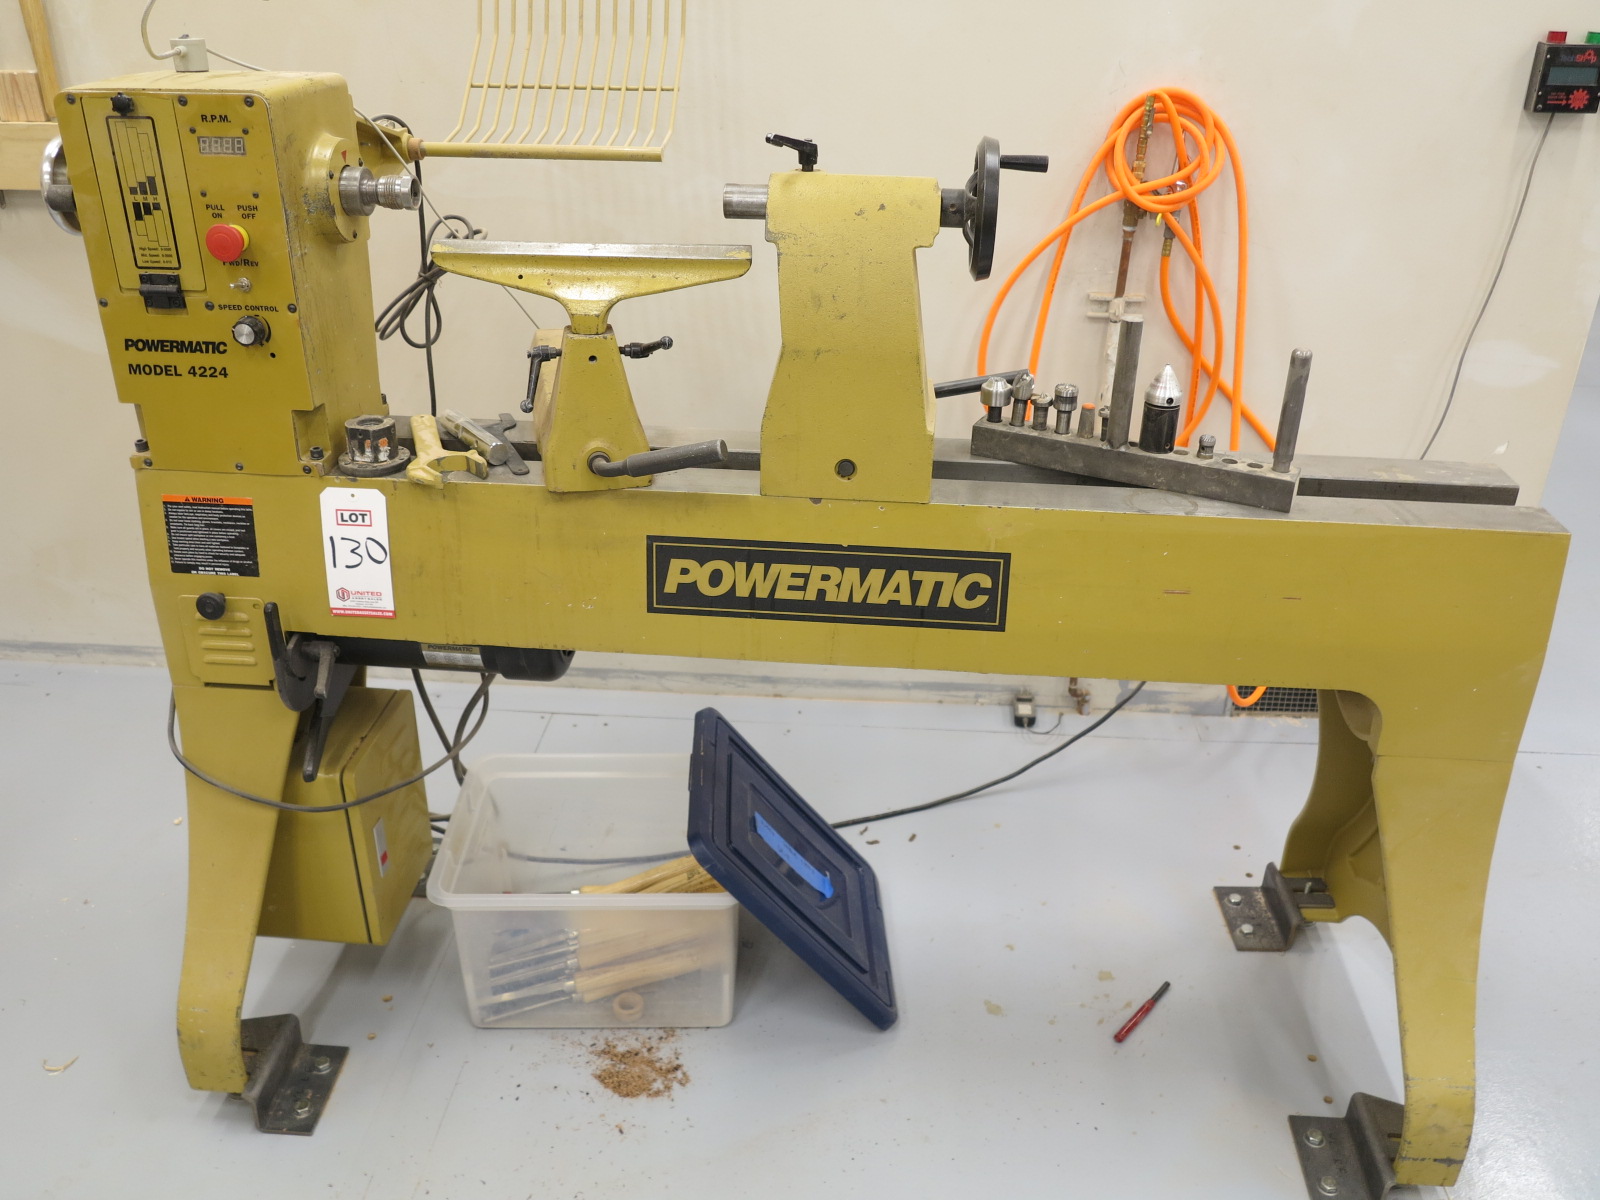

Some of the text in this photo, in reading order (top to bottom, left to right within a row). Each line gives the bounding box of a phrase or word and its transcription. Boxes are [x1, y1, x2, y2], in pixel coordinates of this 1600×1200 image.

[200, 114, 232, 123] R.P.M.
[237, 204, 258, 212] PUSH
[244, 304, 280, 313] CONTROL
[124, 338, 228, 355] POWERMATIC
[128, 363, 229, 379] MODEL 4224
[340, 512, 368, 524] LOT
[329, 535, 388, 569] 130
[663, 558, 993, 611] POWERMATIC
[427, 644, 474, 653] POWERMATIC
